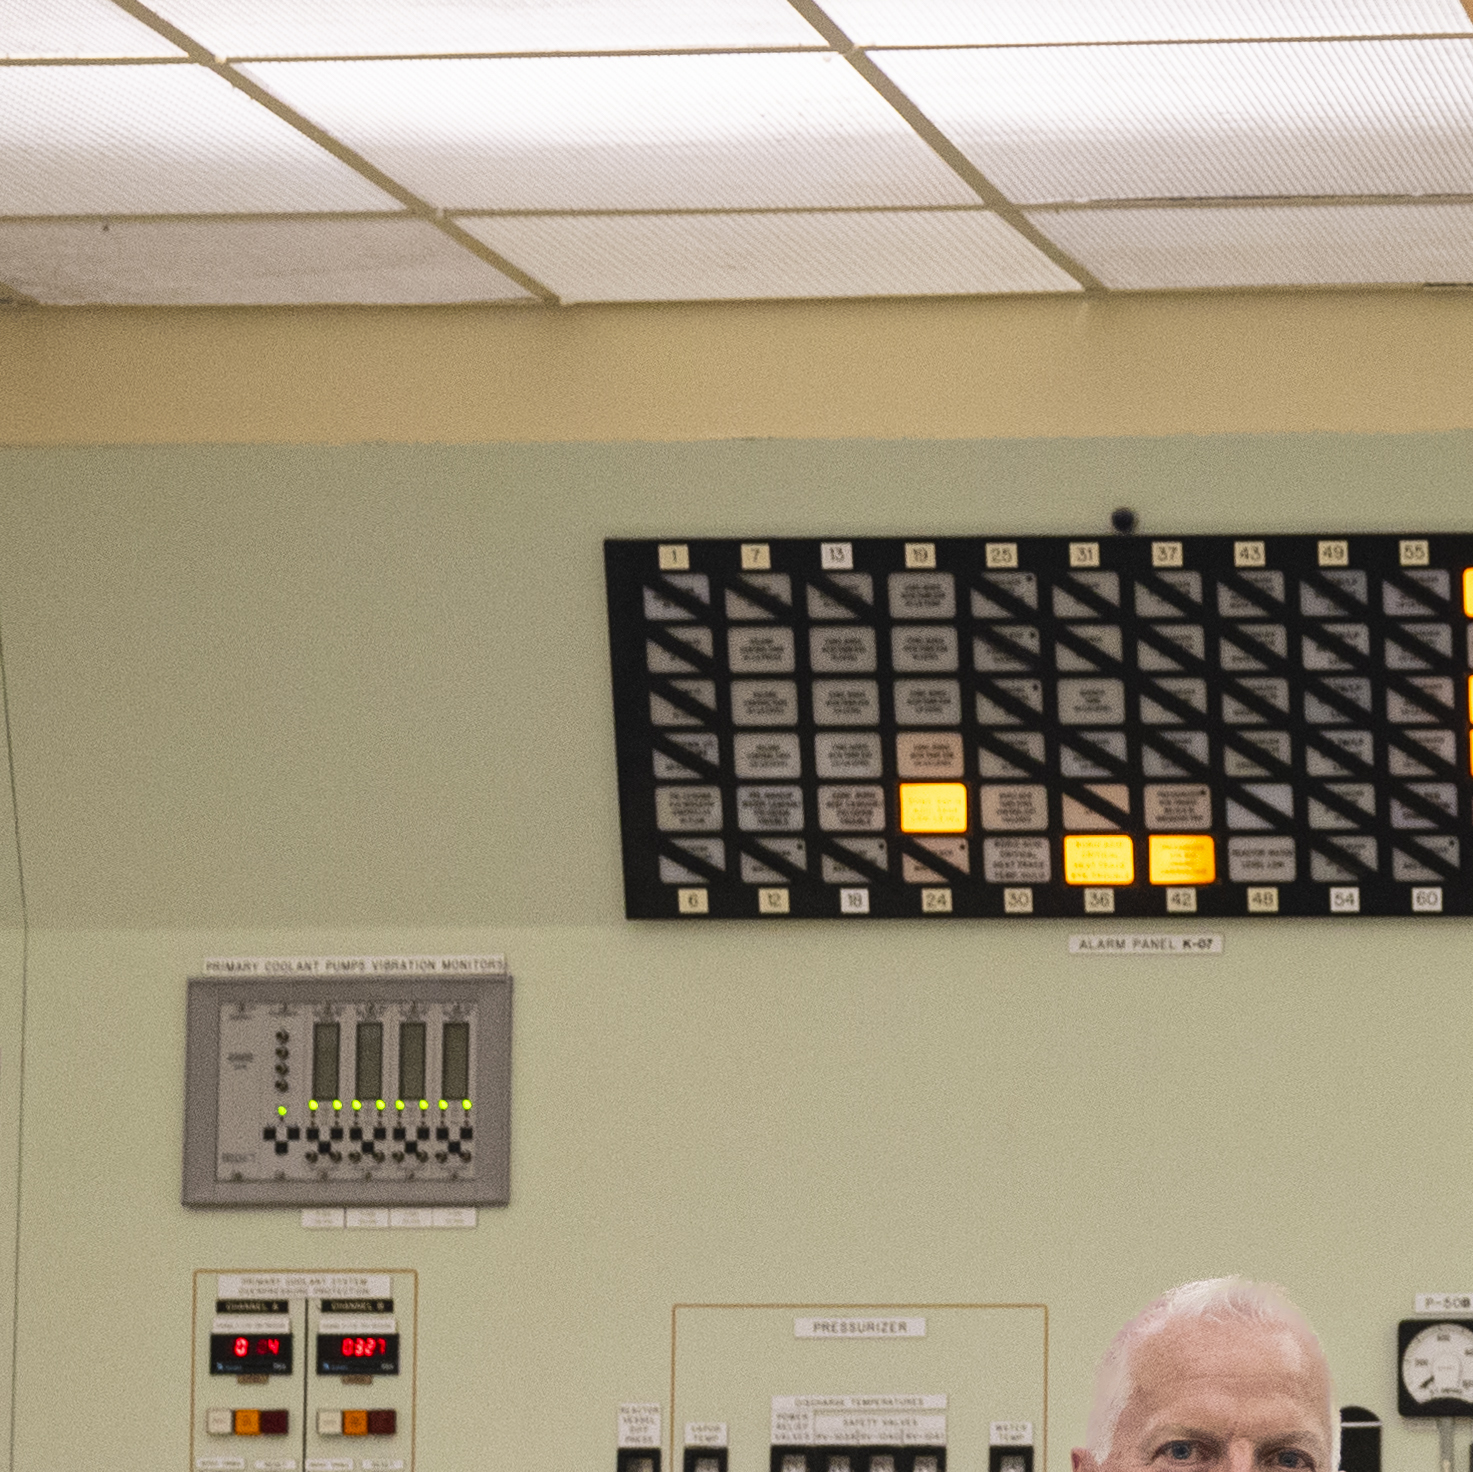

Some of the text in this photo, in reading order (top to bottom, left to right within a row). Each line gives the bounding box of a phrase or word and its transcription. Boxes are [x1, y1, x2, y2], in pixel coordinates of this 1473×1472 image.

[1159, 545, 1176, 560] 37
[1323, 546, 1343, 560] 49
[1405, 545, 1424, 559] 55
[1079, 939, 1126, 949] ALARM
[1133, 939, 1174, 949] PANEL
[206, 960, 435, 972] PRIMARY COOLANT PUMPS VIBRATION
[813, 1322, 907, 1333] PRESSURIZER
